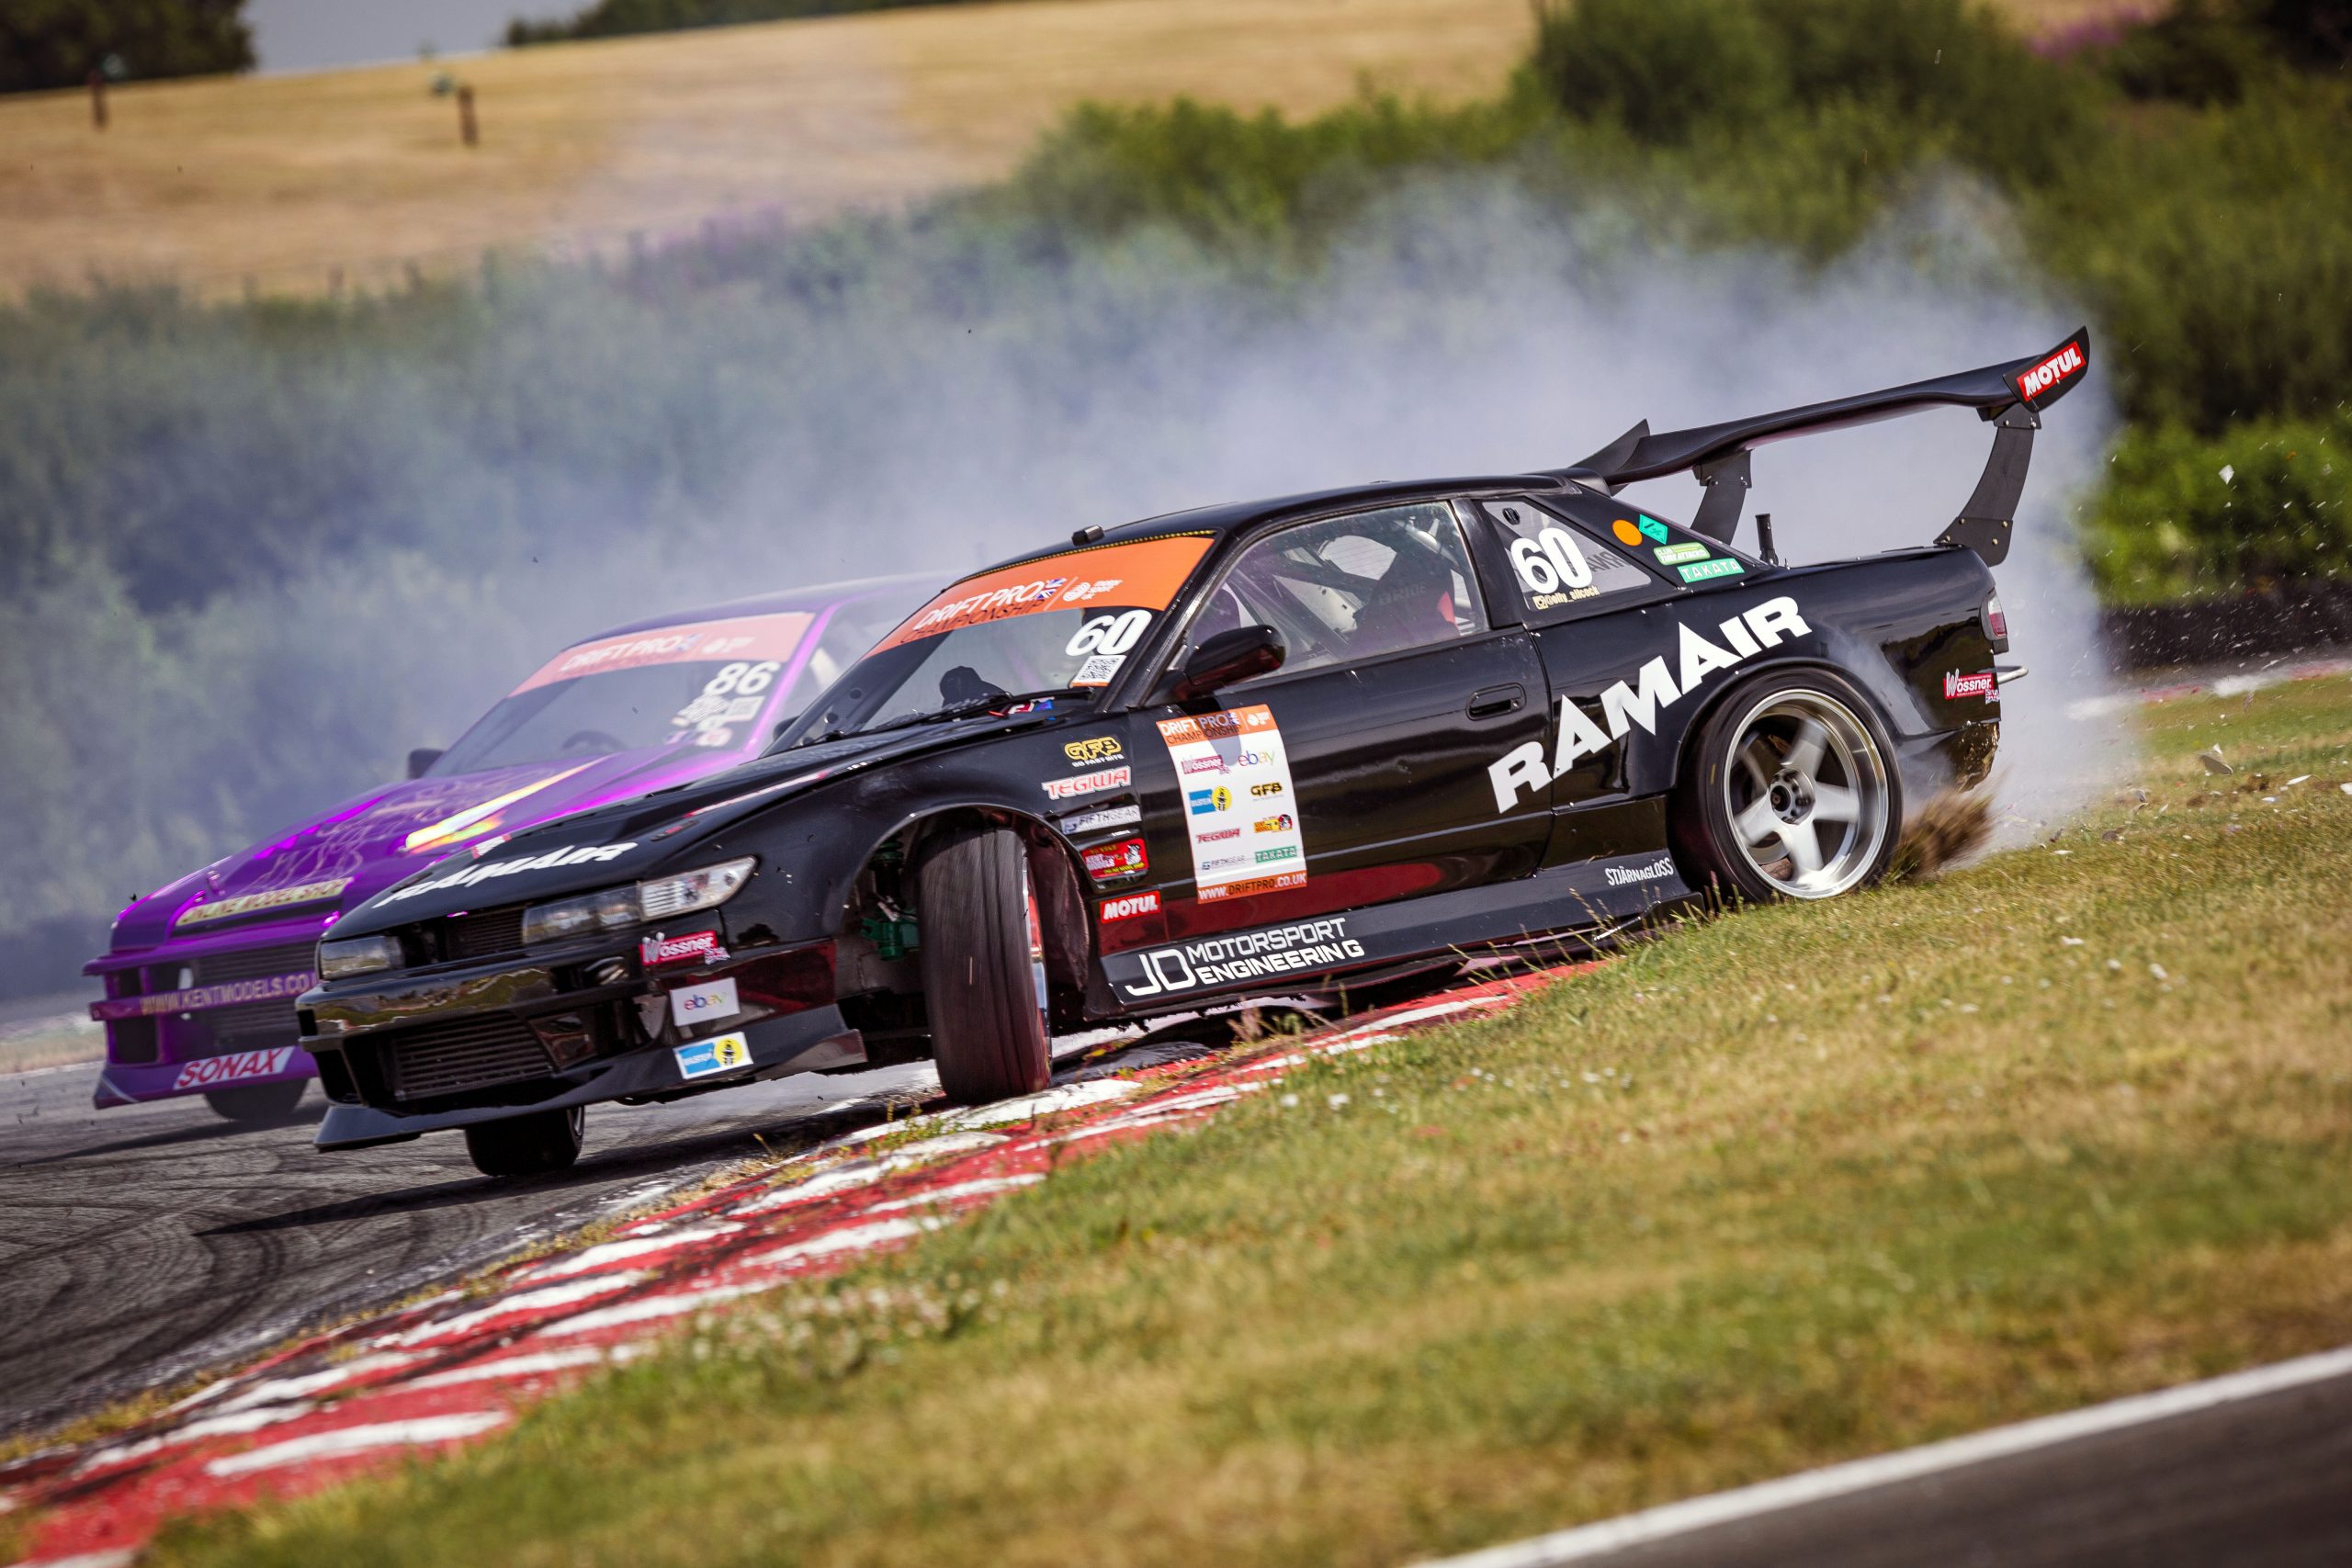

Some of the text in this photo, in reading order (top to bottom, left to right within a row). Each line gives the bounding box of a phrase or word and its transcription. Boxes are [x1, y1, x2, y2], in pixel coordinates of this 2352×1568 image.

[2024, 347, 2082, 397] MOTUL
[1510, 527, 1592, 594] 60
[1681, 560, 1740, 581] TAKATA
[1066, 609, 1152, 657] 60
[704, 660, 781, 695] 86
[1487, 596, 1813, 814] RAMAIR
[1238, 750, 1275, 766] ebay
[1042, 765, 1131, 800] TEGIWA
[1250, 783, 1283, 797] GFB
[1256, 848, 1296, 862] TAKATA
[1605, 857, 1674, 886] STJÄRNAGLOSS
[371, 841, 639, 908] RAMAIR
[1198, 873, 1307, 900] WWW.DRIFTPRO.CO.UK
[1102, 895, 1158, 919] MOTUL
[1125, 918, 1346, 997] JD MOTORSPORT
[1194, 940, 1365, 985] ENGINEERING
[684, 992, 728, 1010] ebay
[179, 1047, 282, 1088] SONAX
